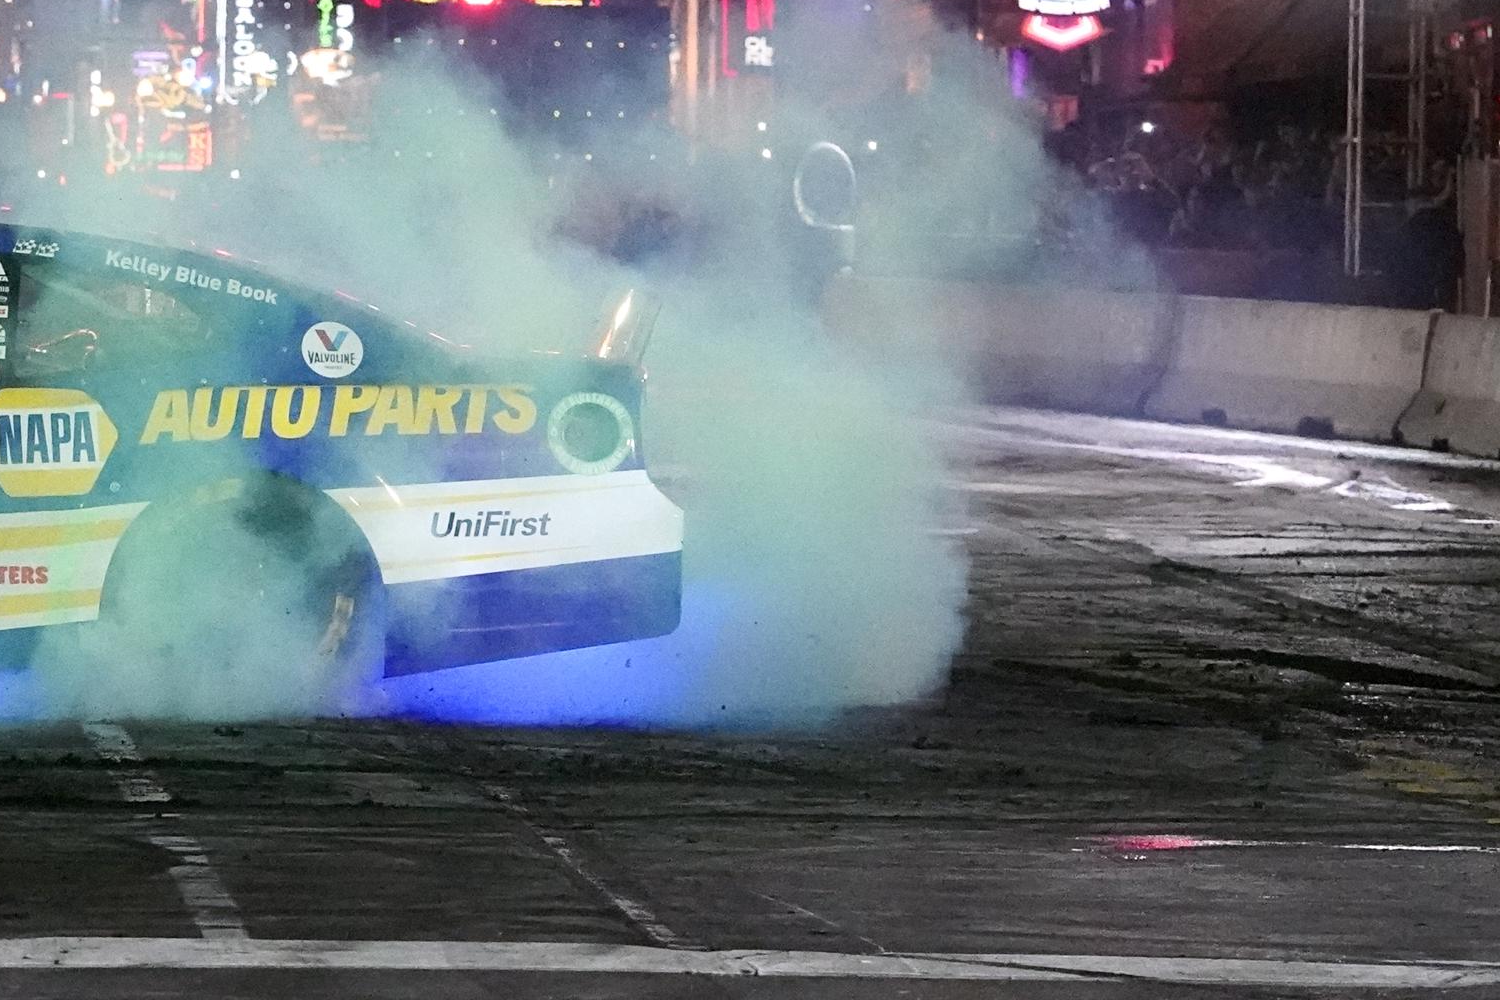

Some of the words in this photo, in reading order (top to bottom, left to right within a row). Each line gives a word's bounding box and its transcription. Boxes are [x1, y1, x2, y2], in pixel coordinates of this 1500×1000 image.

[105, 250, 172, 271] Kelley
[175, 266, 221, 291] Blue
[226, 279, 278, 304] Book
[307, 350, 355, 366] VALVOLINE
[140, 385, 321, 445] AUTO
[329, 384, 538, 437] PARTS
[430, 510, 552, 538] UniFirst
